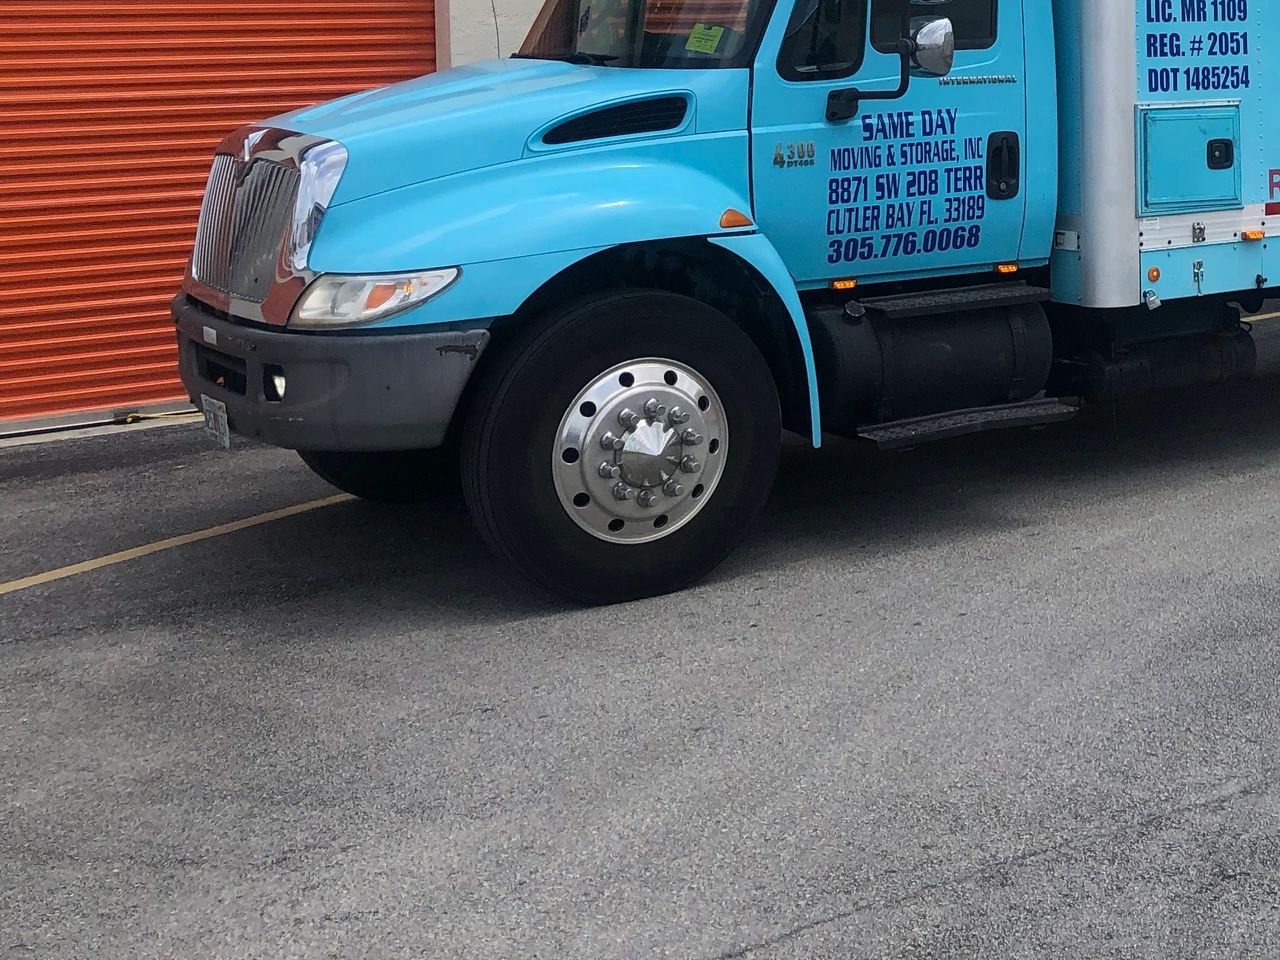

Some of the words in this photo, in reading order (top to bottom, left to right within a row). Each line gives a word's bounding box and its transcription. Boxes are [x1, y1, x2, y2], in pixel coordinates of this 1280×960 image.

[1146, 32, 1186, 58] REG.
[1189, 34, 1204, 57] #
[1207, 31, 1248, 56] 2051
[939, 75, 1017, 86] INTERNATIONAL
[1147, 67, 1180, 93] DOT
[1183, 65, 1250, 91] 1485254
[861, 111, 915, 141] SAME
[921, 108, 957, 137] DAY
[830, 145, 882, 172] MOVING
[886, 144, 896, 167] &
[900, 139, 960, 164] STORAGE,
[964, 137, 984, 160] INC
[828, 176, 869, 205] 8871
[875, 172, 901, 201] SW
[906, 169, 939, 198] 208
[944, 165, 984, 194] TERR
[826, 205, 881, 236] CUTLER
[885, 201, 916, 230] BAY
[918, 199, 939, 227] FL.
[943, 195, 985, 224] 33189
[827, 224, 982, 264] 305.776.0068
